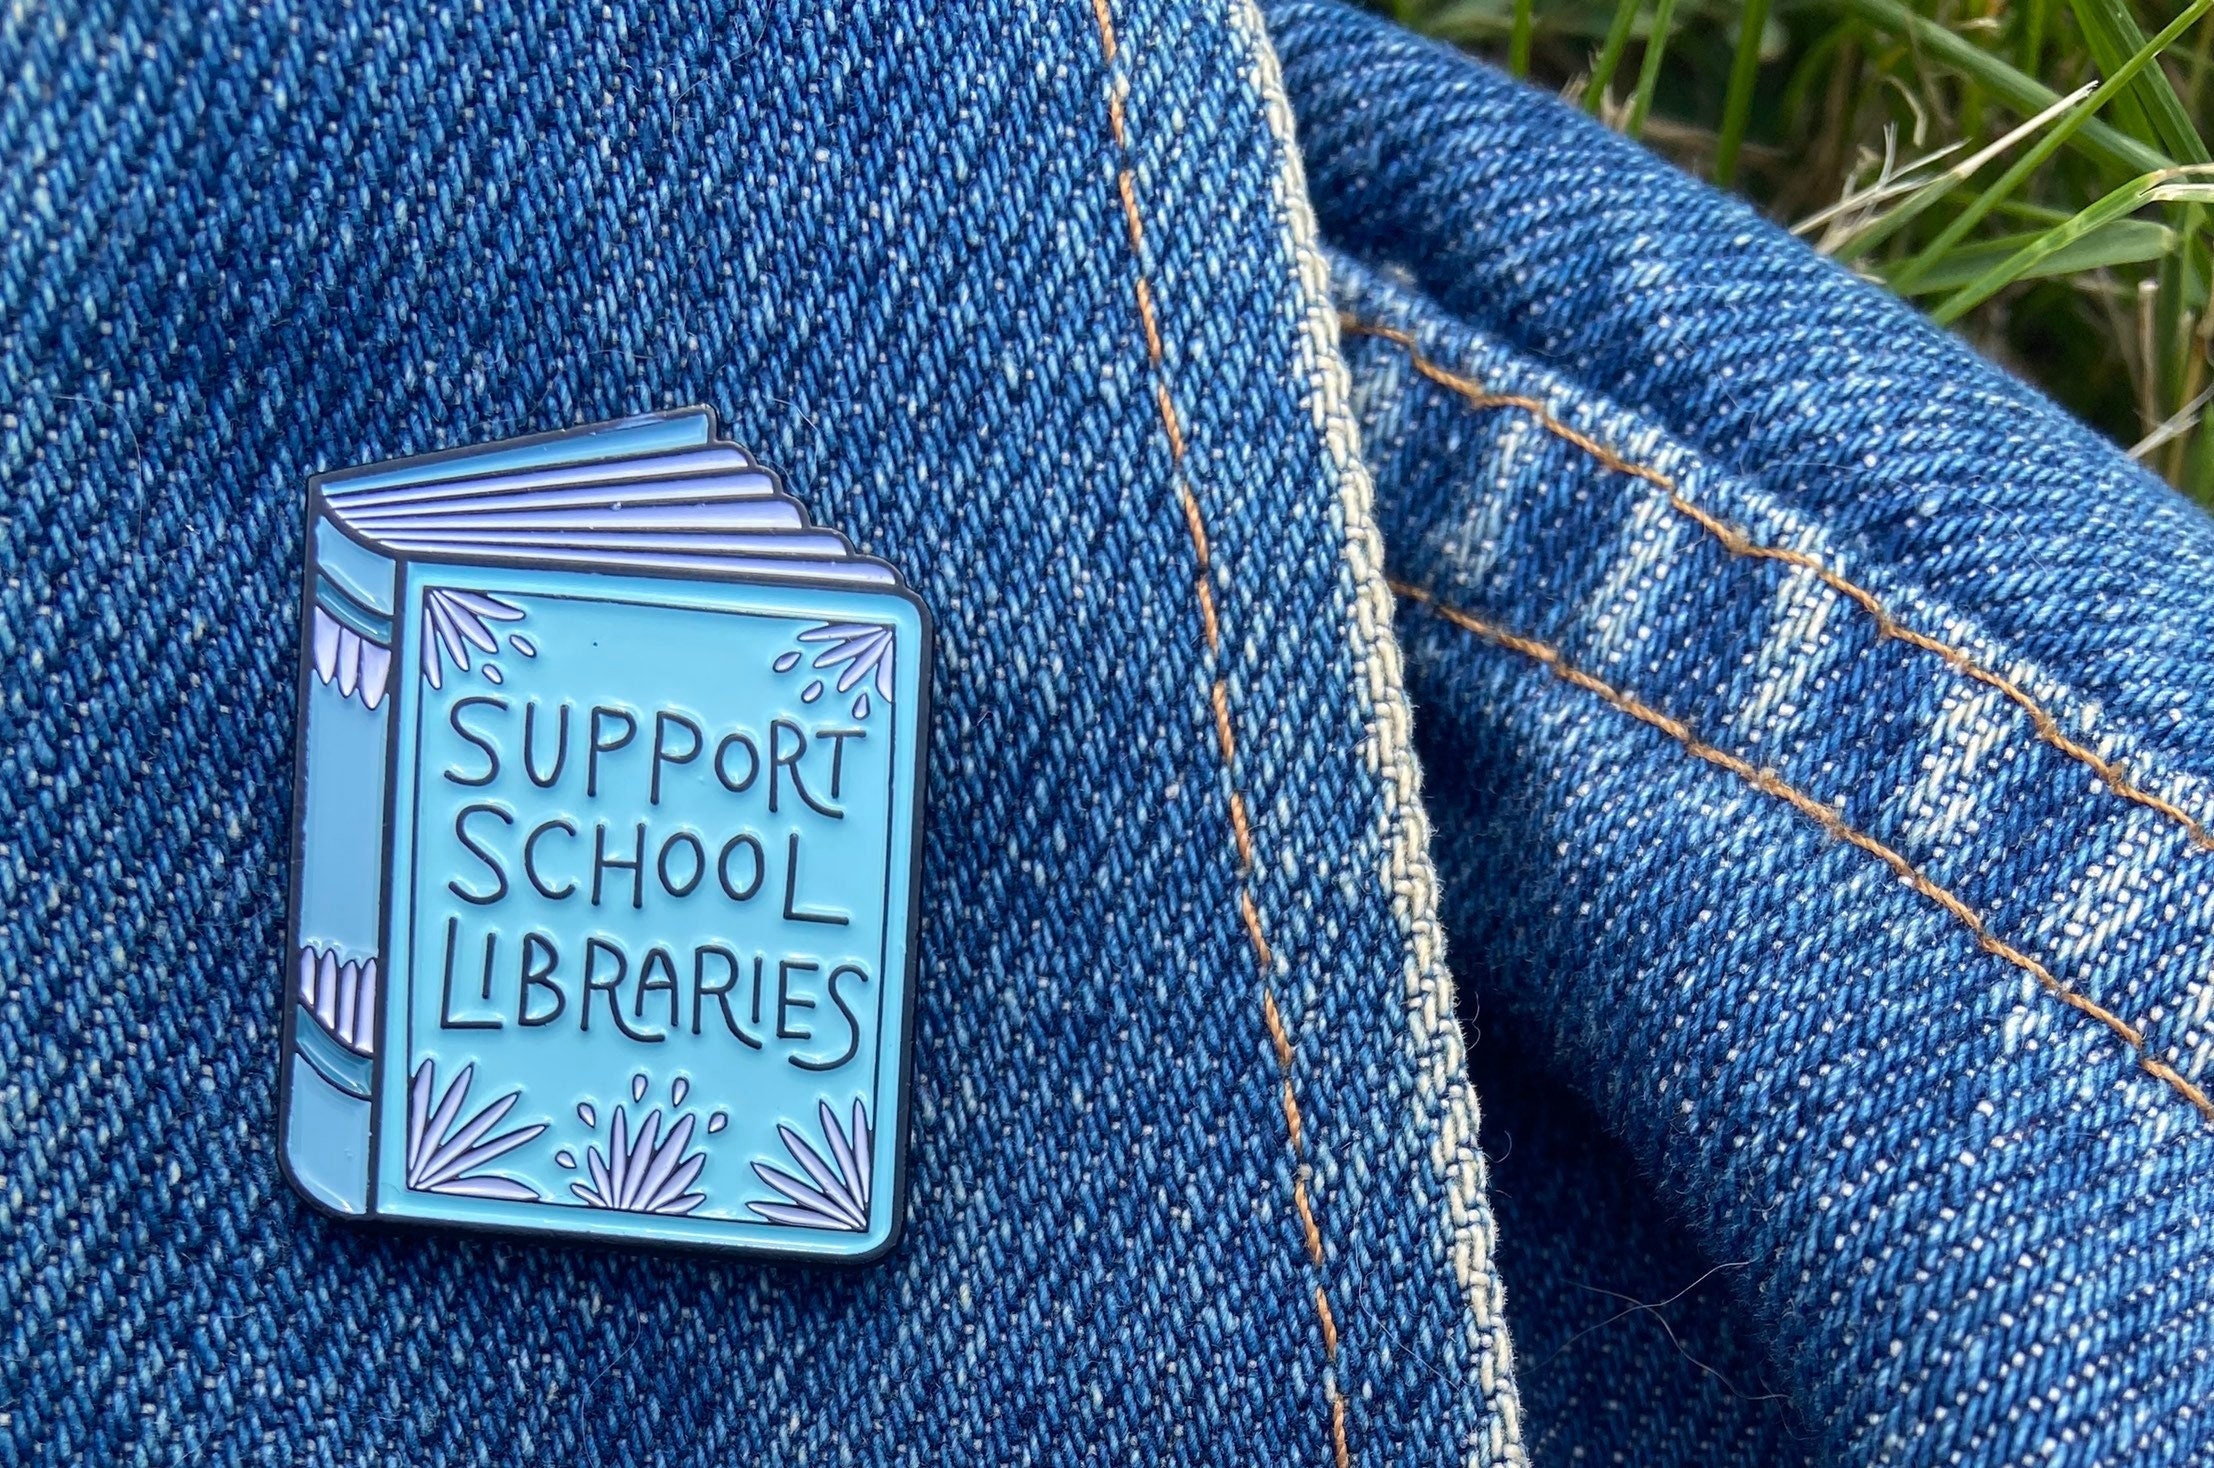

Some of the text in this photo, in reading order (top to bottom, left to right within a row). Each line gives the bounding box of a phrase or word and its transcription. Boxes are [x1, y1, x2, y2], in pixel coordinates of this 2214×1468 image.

[443, 695, 868, 819] SUPPORT
[448, 803, 850, 925] SCHOOL
[440, 916, 869, 1072] LIBRARIES
